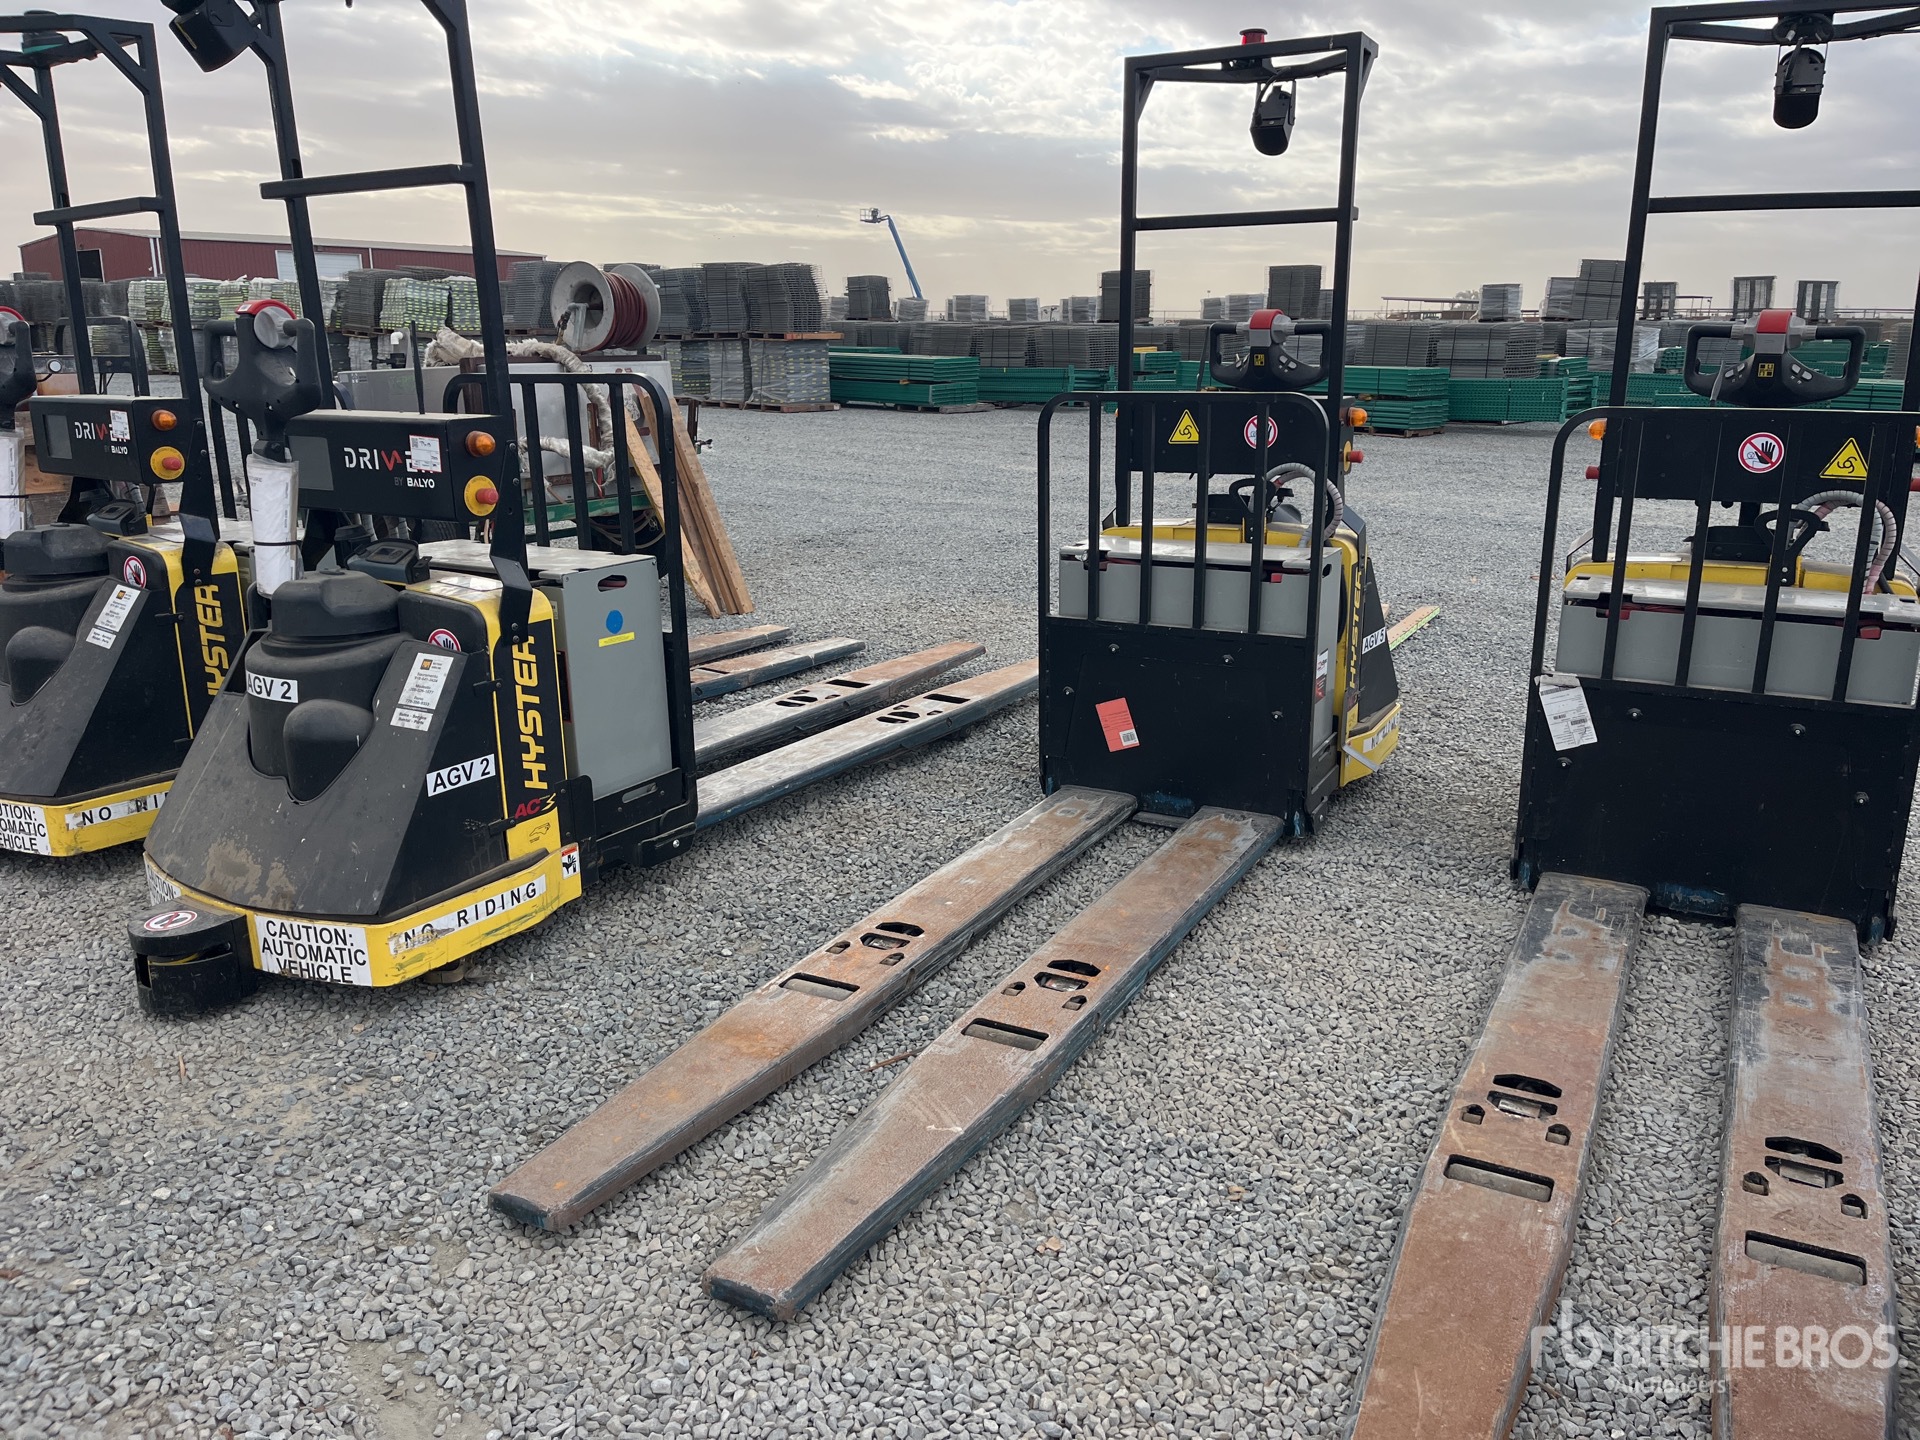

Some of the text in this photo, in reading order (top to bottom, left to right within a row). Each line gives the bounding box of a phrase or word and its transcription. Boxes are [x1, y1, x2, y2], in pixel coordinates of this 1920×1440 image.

[111, 445, 128, 455] BALYO
[406, 477, 435, 488] BALYO
[194, 584, 230, 696] YSTER
[1363, 628, 1385, 652] AGV 5
[247, 673, 292, 700] AGV 2
[512, 635, 548, 790] HYSTER
[433, 757, 491, 793] AGV 2
[81, 806, 112, 826] NO
[456, 882, 537, 928] RIDING
[266, 920, 354, 947] CAUTION:
[261, 937, 367, 966] AUTOMATIC
[276, 957, 354, 984] VEHICLE
